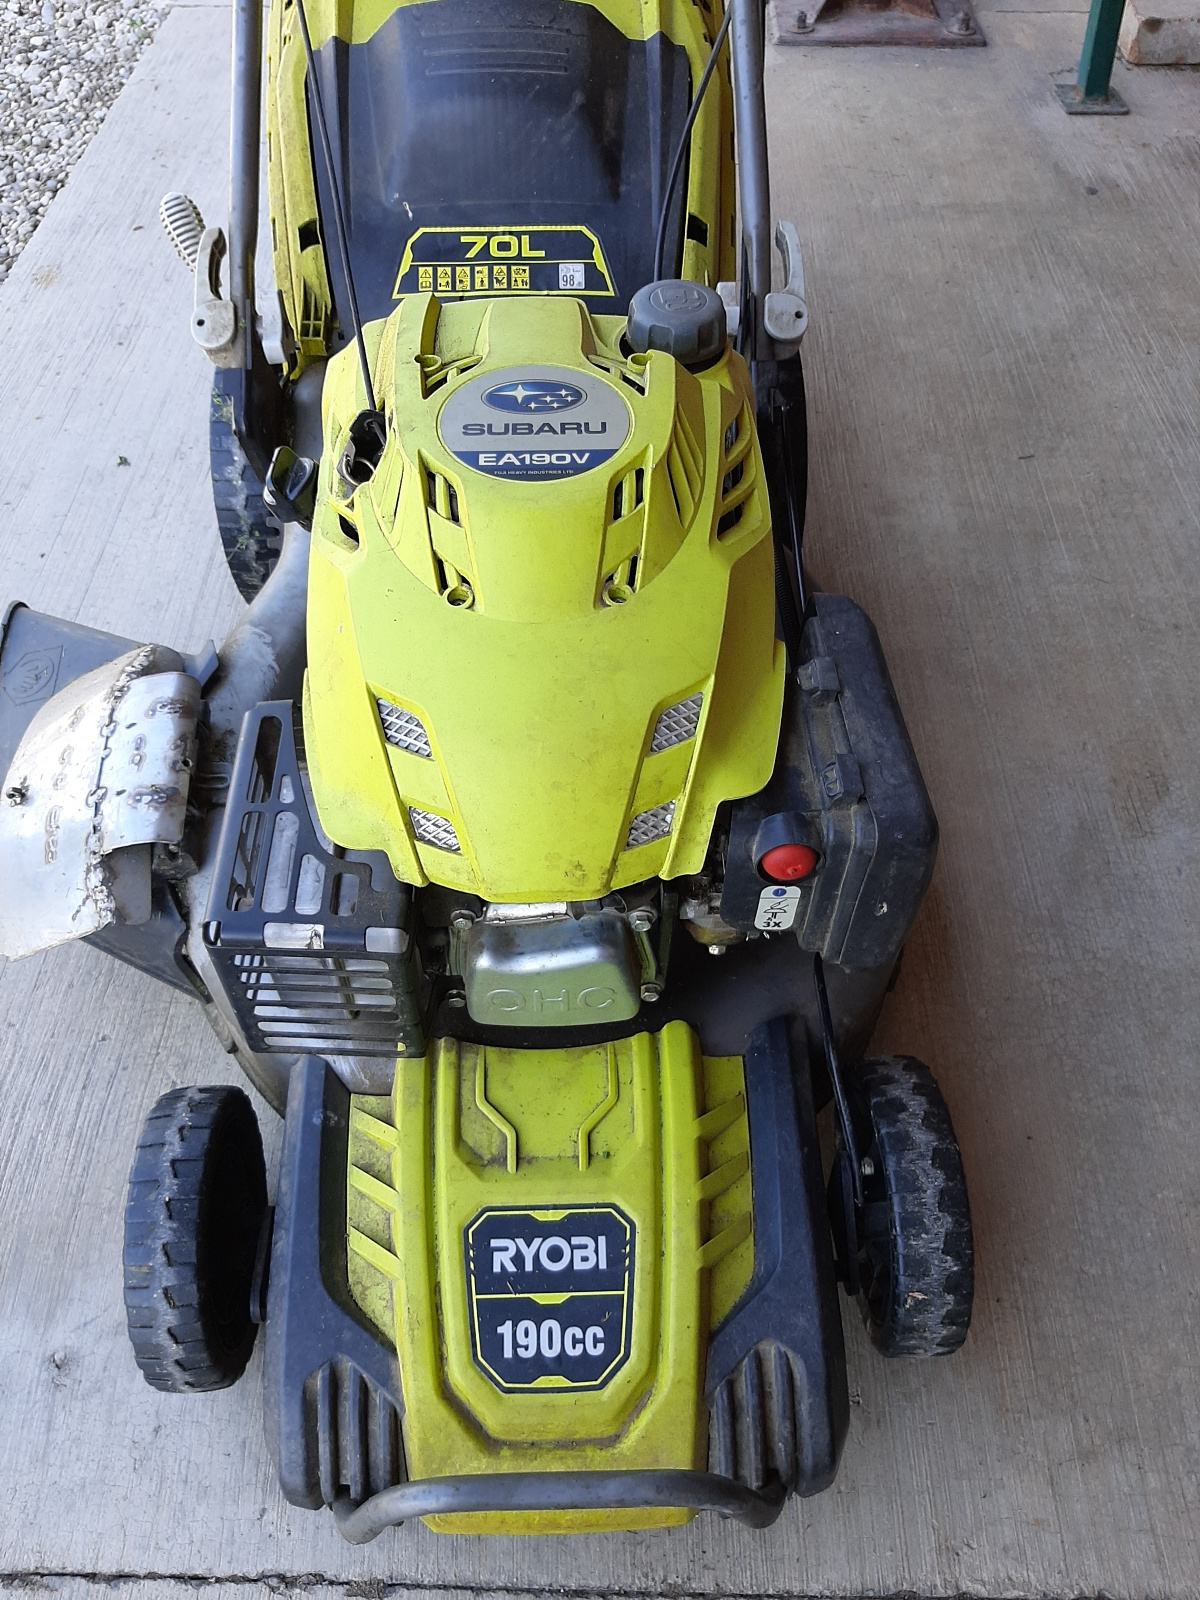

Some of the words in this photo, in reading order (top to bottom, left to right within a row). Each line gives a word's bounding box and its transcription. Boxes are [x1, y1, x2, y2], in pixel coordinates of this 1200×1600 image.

[460, 235, 545, 258] 70L
[562, 274, 575, 287] 98
[462, 421, 607, 436] SUBARU
[478, 452, 590, 466] EA190V
[486, 986, 617, 1013] OHC
[490, 1235, 608, 1273] RYOBI
[496, 1318, 605, 1359] 190cc
